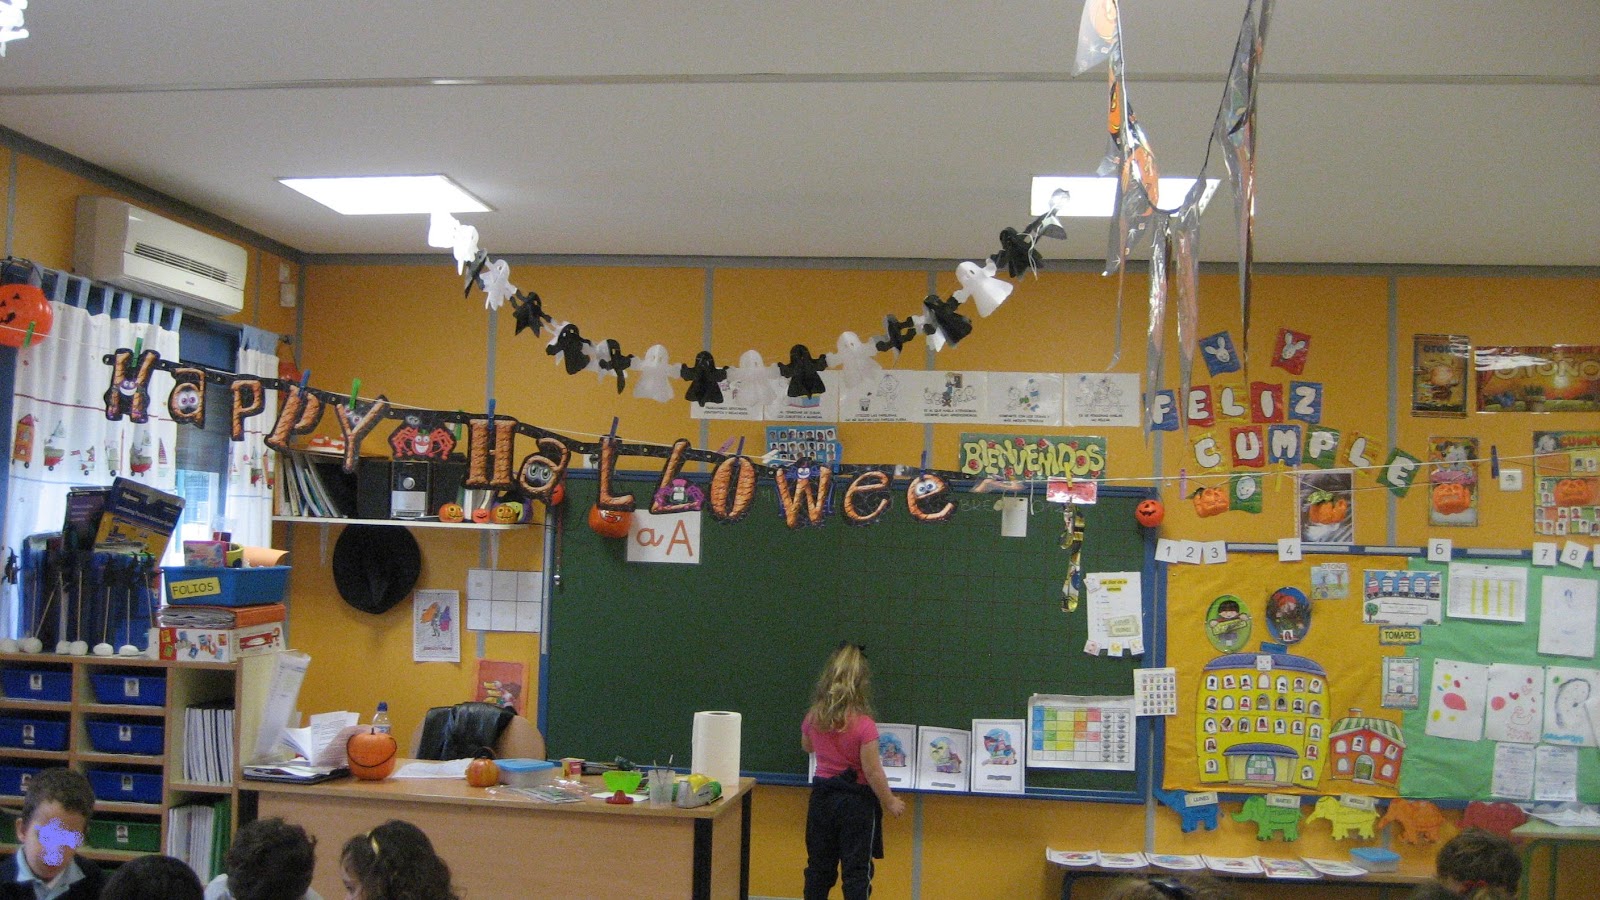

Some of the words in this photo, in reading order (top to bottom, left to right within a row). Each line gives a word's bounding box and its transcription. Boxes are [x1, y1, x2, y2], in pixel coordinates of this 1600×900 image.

[1152, 386, 1317, 424] FELIZ
[961, 439, 1105, 476] BIENVENIDOS
[1194, 429, 1415, 487] CUMPLE
[1166, 546, 1171, 557] 1
[1186, 547, 1195, 558] 2
[1210, 547, 1219, 558] 3
[1286, 545, 1293, 555] 4
[1435, 543, 1444, 555] 6
[1541, 549, 1548, 560] 7
[1569, 549, 1578, 560] 8
[172, 582, 214, 595] FOLIOS
[1384, 630, 1417, 640] TOMARES
